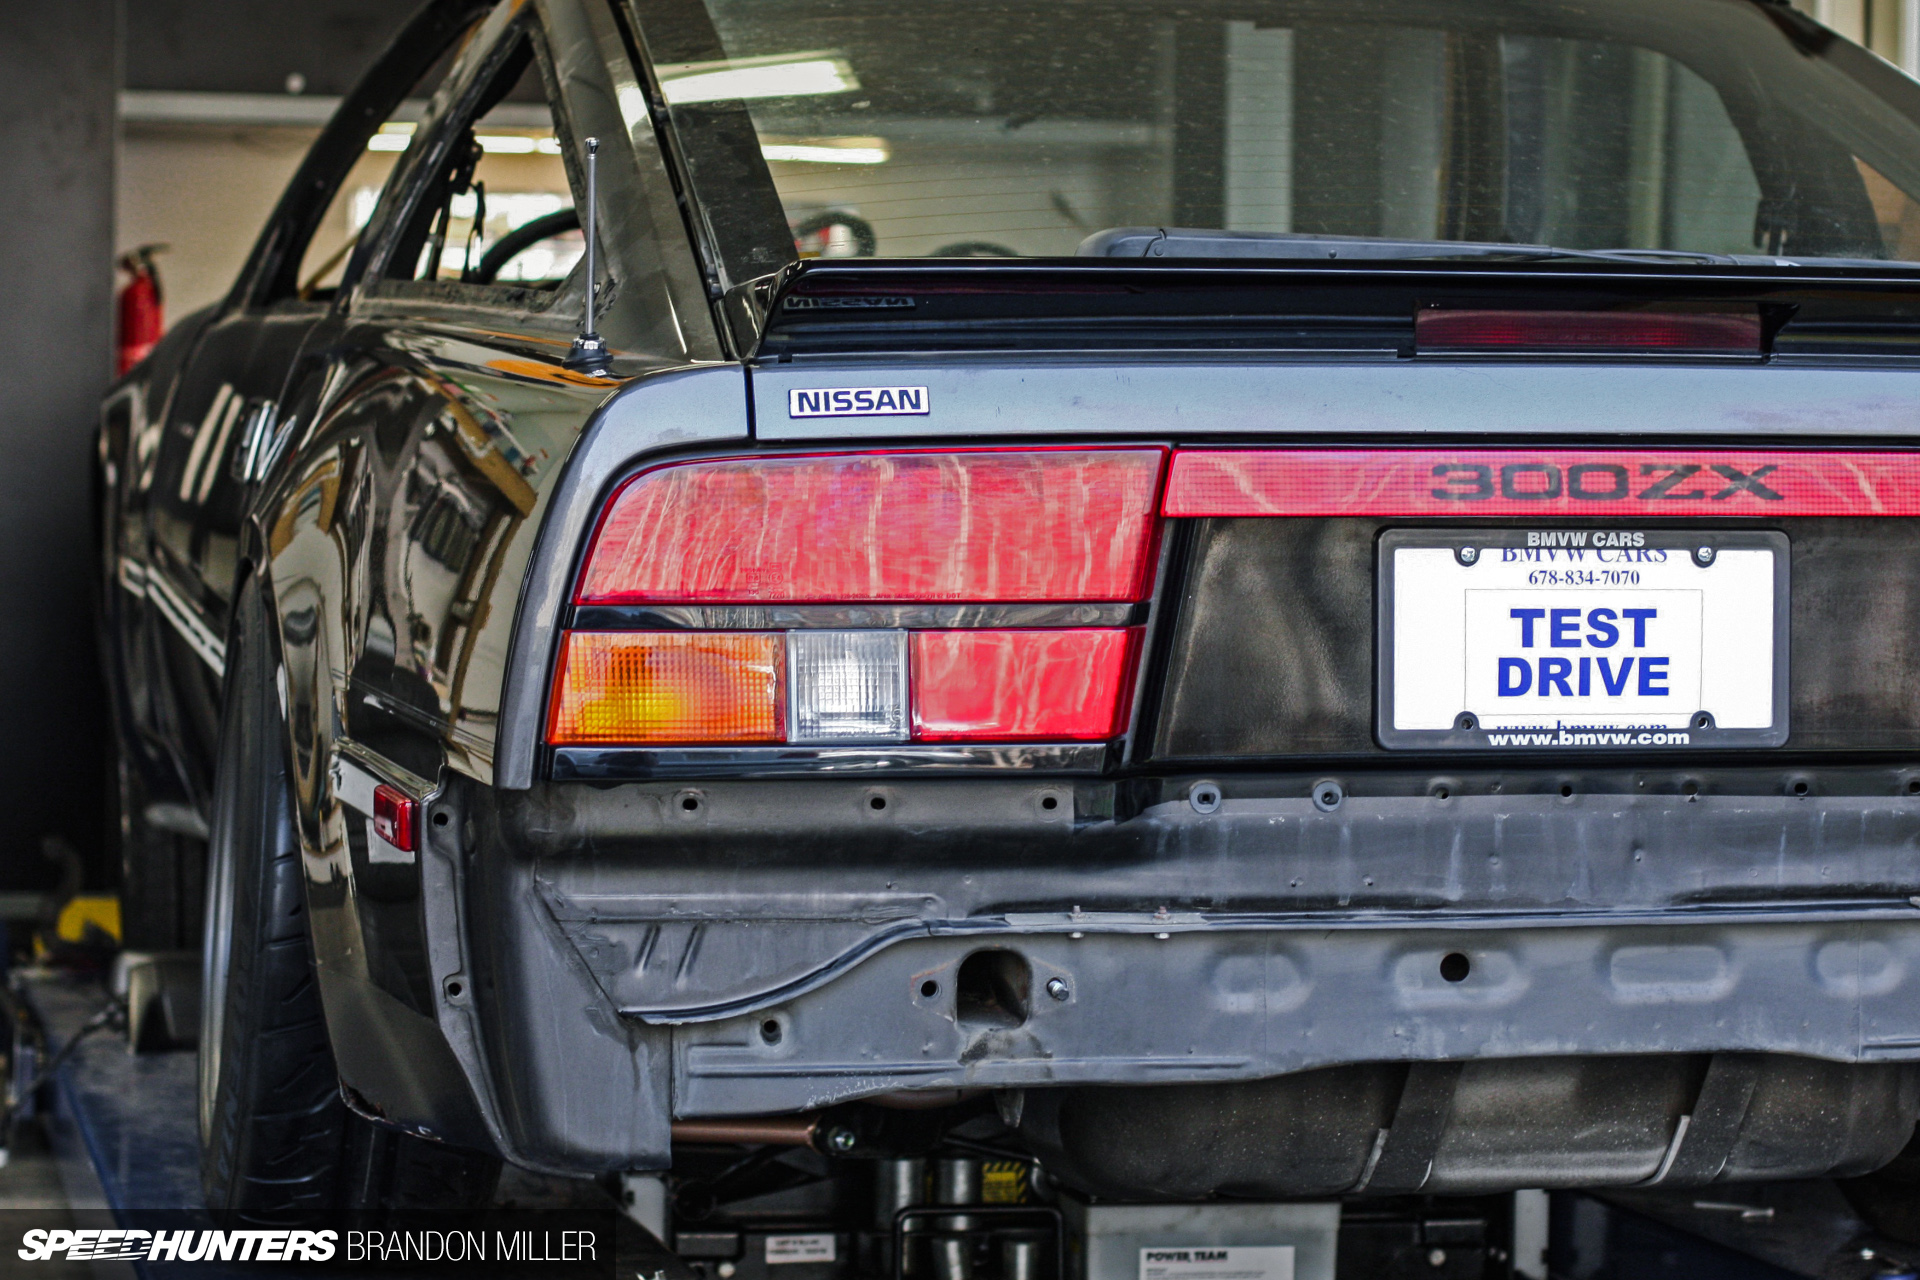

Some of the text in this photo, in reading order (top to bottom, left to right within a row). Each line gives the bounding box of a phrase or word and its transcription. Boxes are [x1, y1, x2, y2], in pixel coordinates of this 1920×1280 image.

[798, 389, 921, 412] NISSAN
[1431, 463, 1784, 501] 300ZX
[1527, 531, 1645, 547] BMVW CARS
[1528, 570, 1640, 585] 678-834-7070
[1510, 608, 1657, 648] TEST
[1497, 657, 1670, 697] DRIVE
[1488, 730, 1690, 746] www.bmvw.com
[1146, 1251, 1228, 1262] POWER TEAM
